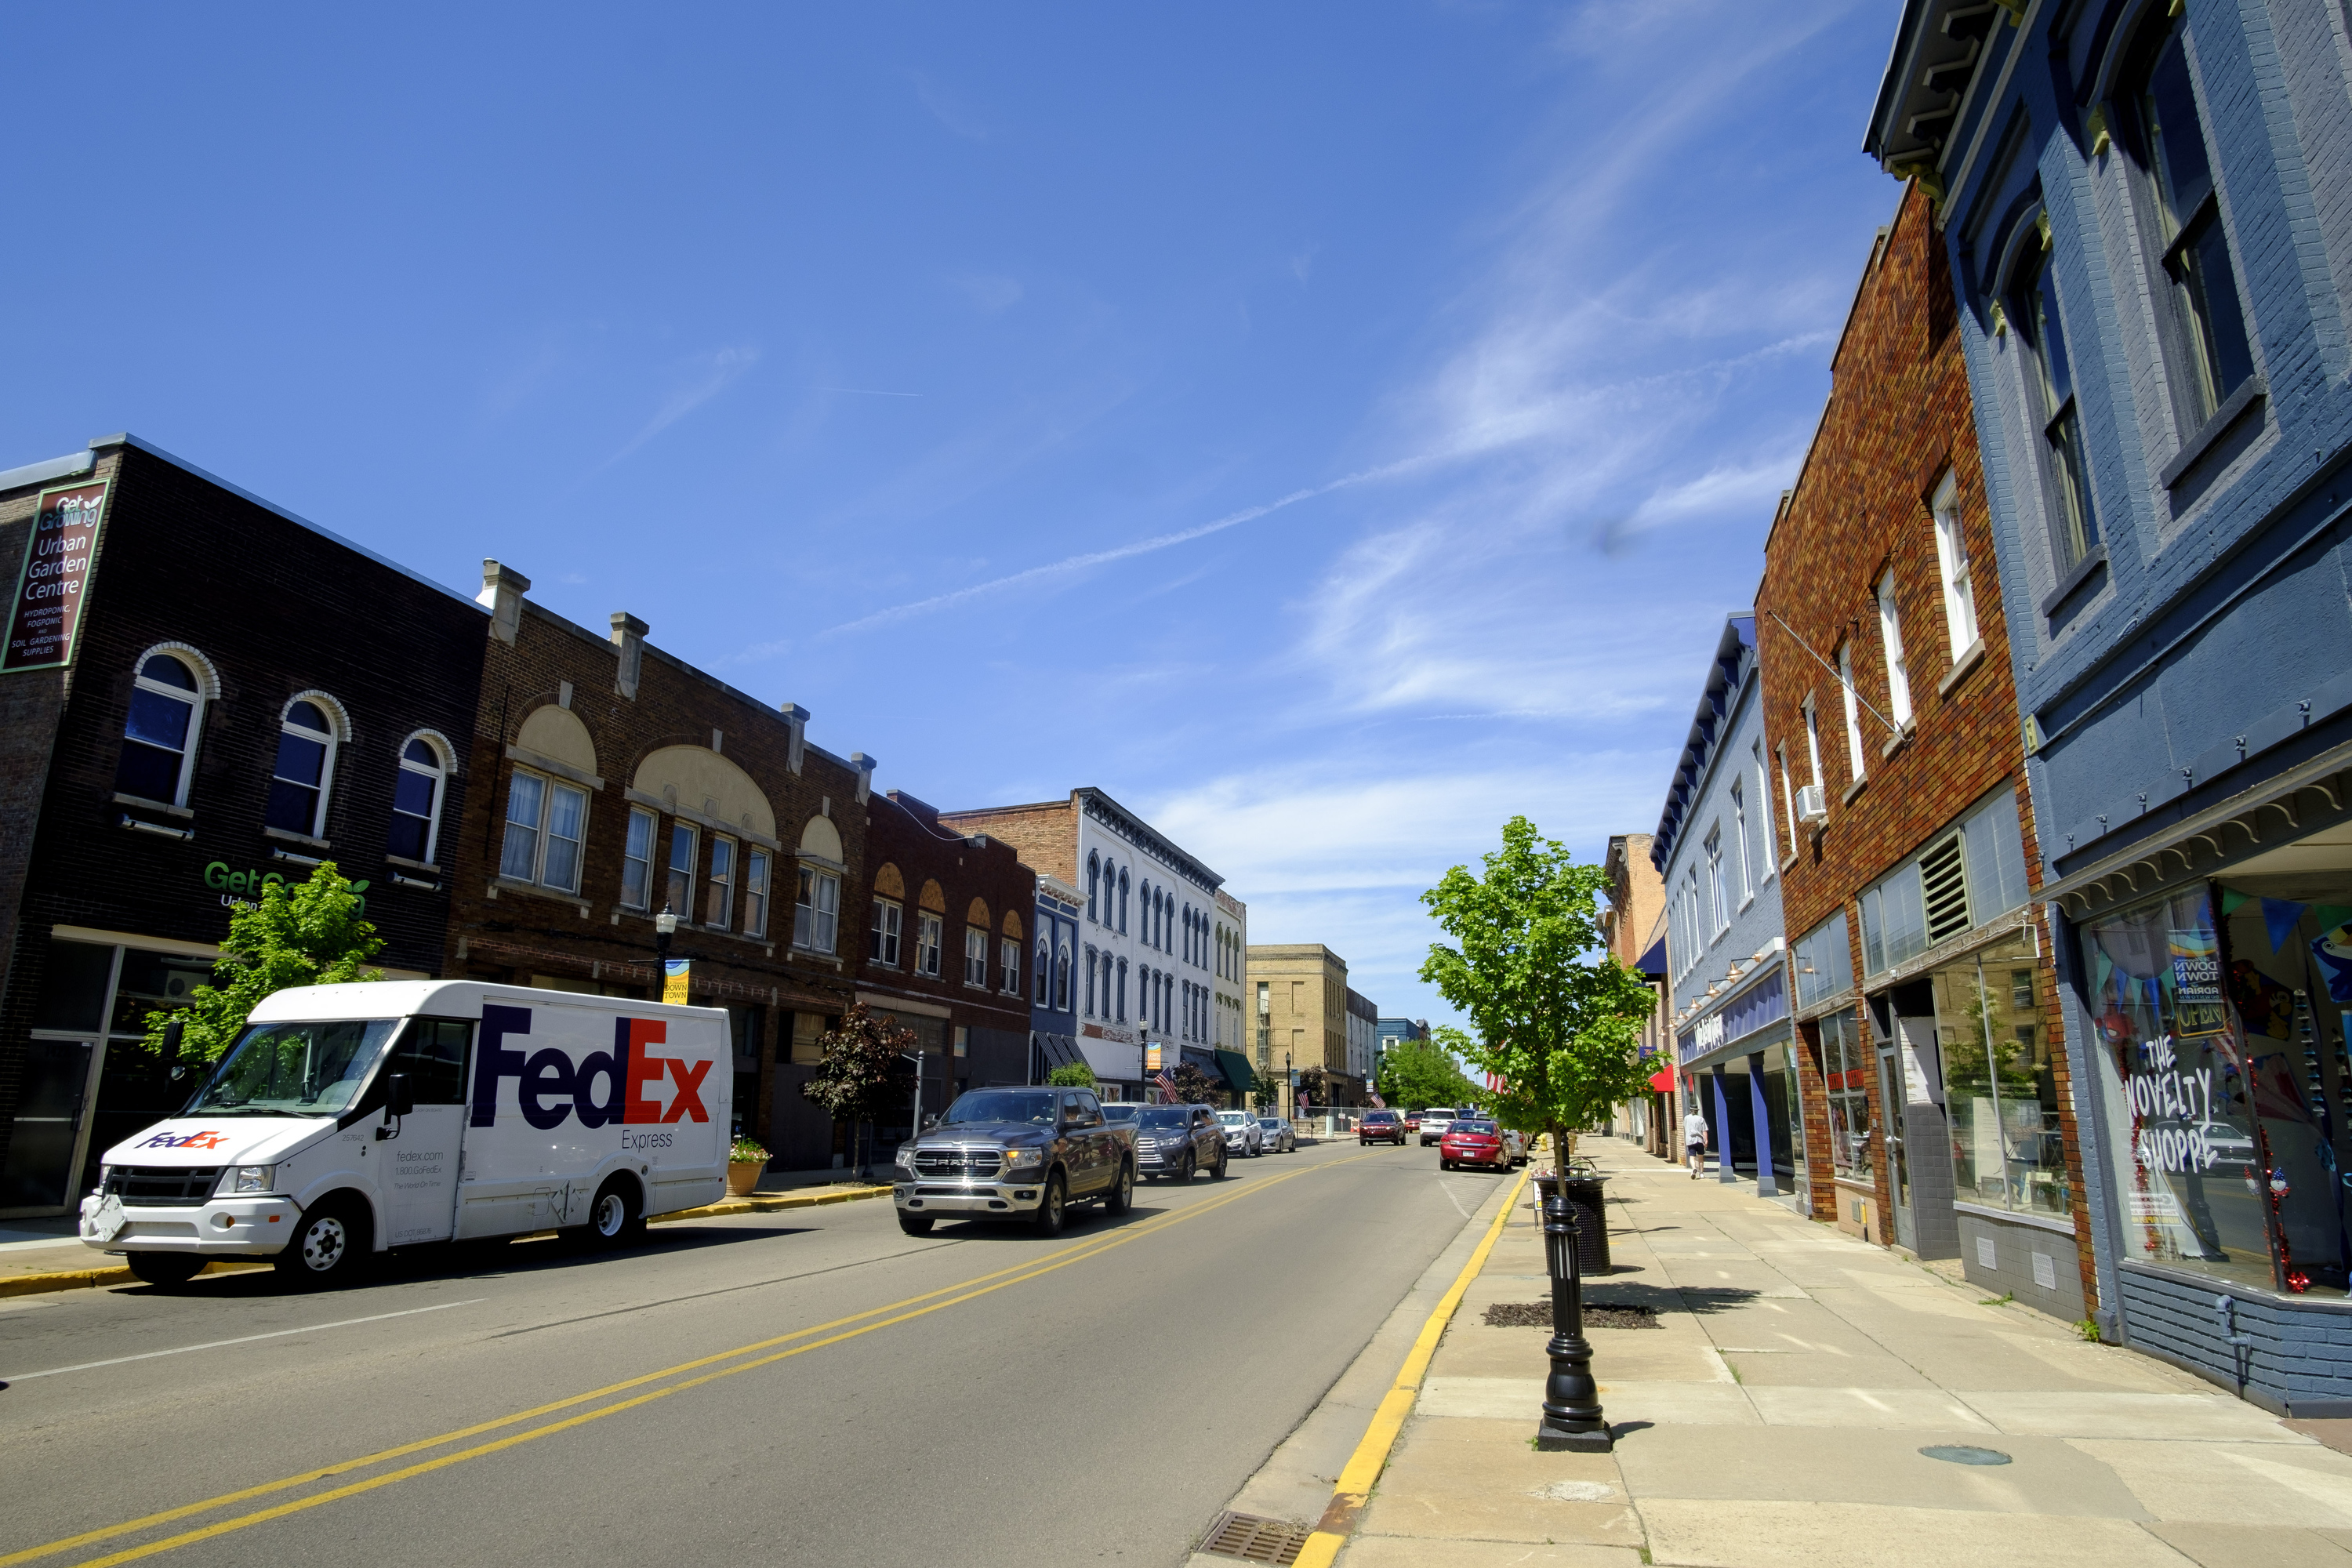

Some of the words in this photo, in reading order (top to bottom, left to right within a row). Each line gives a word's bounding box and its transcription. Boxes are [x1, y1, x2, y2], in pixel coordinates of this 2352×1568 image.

[56, 495, 84, 515] Get
[40, 508, 97, 531] Growing
[38, 535, 86, 556] Urban
[29, 557, 86, 579] Garden
[25, 579, 79, 600] Centre
[24, 604, 71, 618] HYDROPONIC,
[27, 616, 63, 627] FOGPONIC
[12, 639, 27, 648] SOIL
[30, 633, 71, 645] GARDENING
[22, 645, 53, 657] SUPPLIES
[204, 861, 260, 896] Get
[220, 895, 258, 911] Uran
[2179, 1004, 2222, 1027] OPEN
[2146, 1034, 2176, 1073] THE
[470, 1004, 713, 1130] FedEx
[2125, 1067, 2211, 1127] NOVELTY
[132, 1131, 230, 1149] FedEx
[621, 1130, 673, 1152] Express
[2140, 1124, 2218, 1177] SHOPPE
[397, 1150, 444, 1162] fedex.com
[395, 1165, 442, 1175] 1.800.GoFedEx
[404, 1229, 416, 1237] DOT
